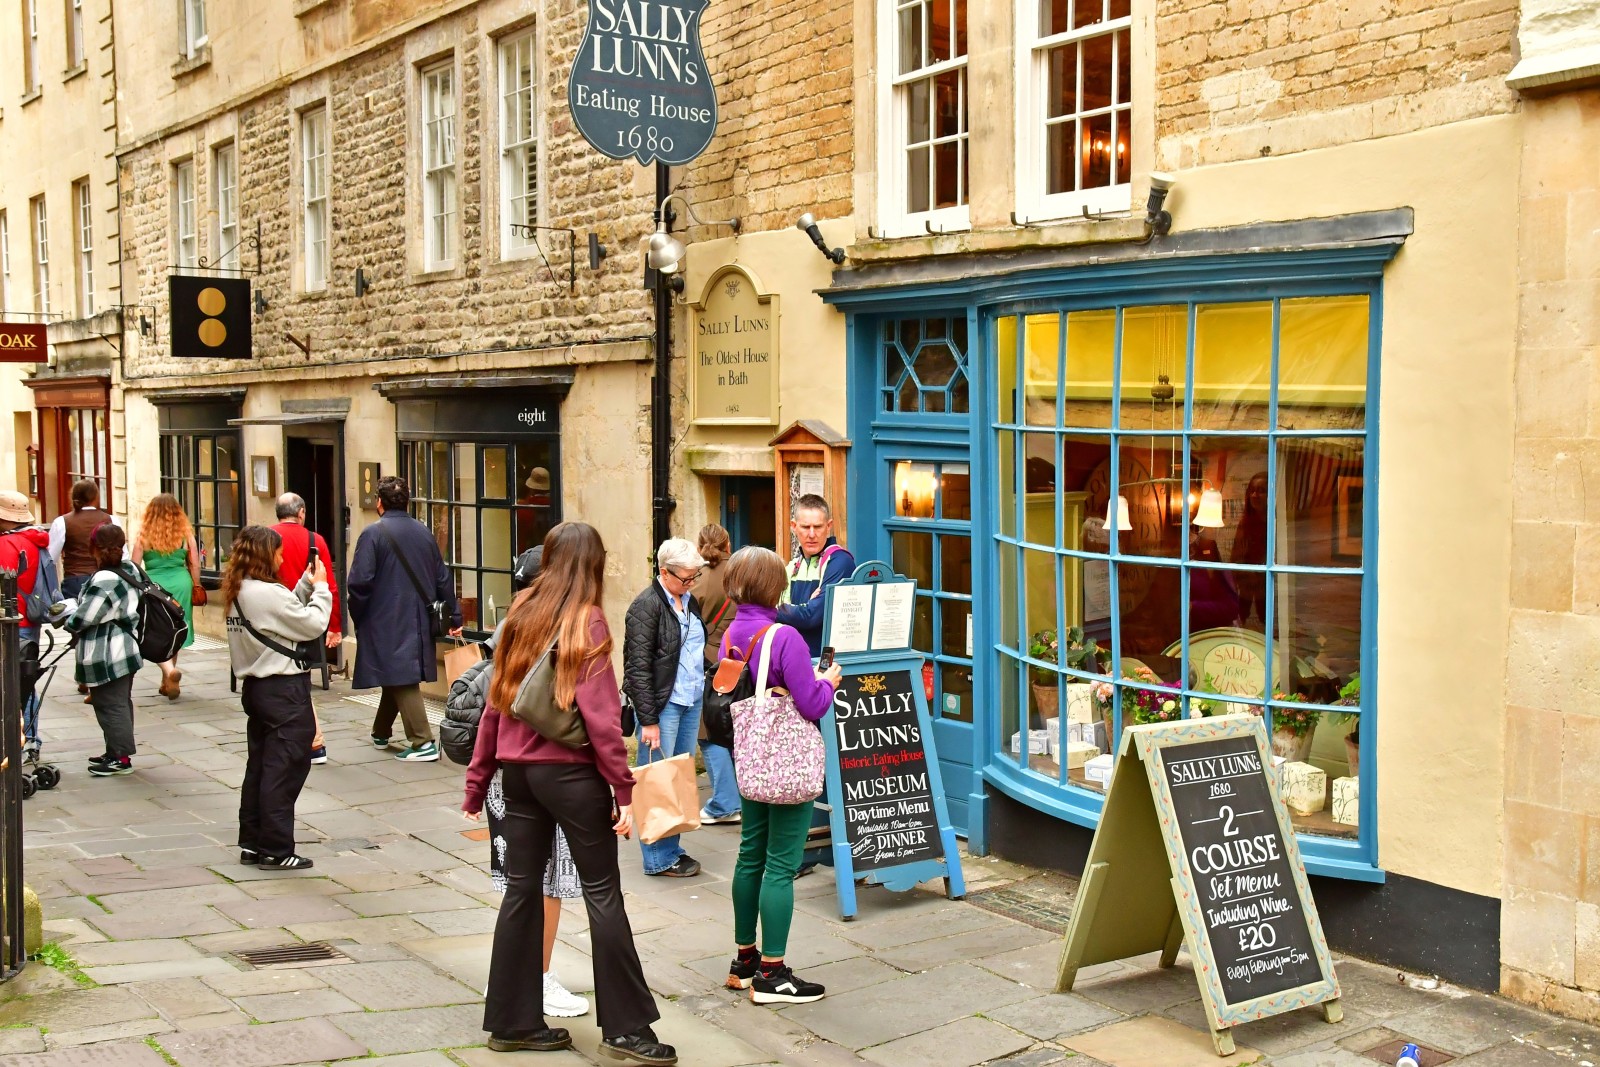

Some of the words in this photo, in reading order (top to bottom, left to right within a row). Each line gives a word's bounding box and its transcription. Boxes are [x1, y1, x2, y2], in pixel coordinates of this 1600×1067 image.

[596, 0, 696, 44] SALLY
[576, 84, 641, 118] Eating
[651, 95, 711, 124] House
[617, 125, 674, 153] 1680
[0, 333, 38, 348] OAK
[699, 351, 713, 366] The
[716, 350, 740, 365] Oldest
[744, 348, 769, 364] House
[718, 374, 726, 386] in
[728, 370, 748, 386] Bath
[517, 408, 547, 426] eight
[1214, 646, 1256, 664] SALLY
[1223, 666, 1248, 679] 1680
[833, 689, 912, 720] SALLY
[841, 756, 872, 769] Historic
[873, 752, 900, 766] Eating
[900, 749, 924, 762] House
[1171, 758, 1217, 783] SALLY
[845, 773, 928, 801] MUSEUM
[1209, 782, 1232, 797] 1680
[848, 804, 896, 824] Daytime
[897, 800, 930, 816] Menu
[1218, 805, 1240, 837] 2
[877, 830, 927, 850] DINNER
[874, 850, 896, 864] from
[1191, 833, 1280, 875] COURSE
[1208, 874, 1234, 900] Set
[1234, 872, 1281, 895] Menu
[1207, 903, 1260, 928] Including
[1238, 922, 1276, 951] £20
